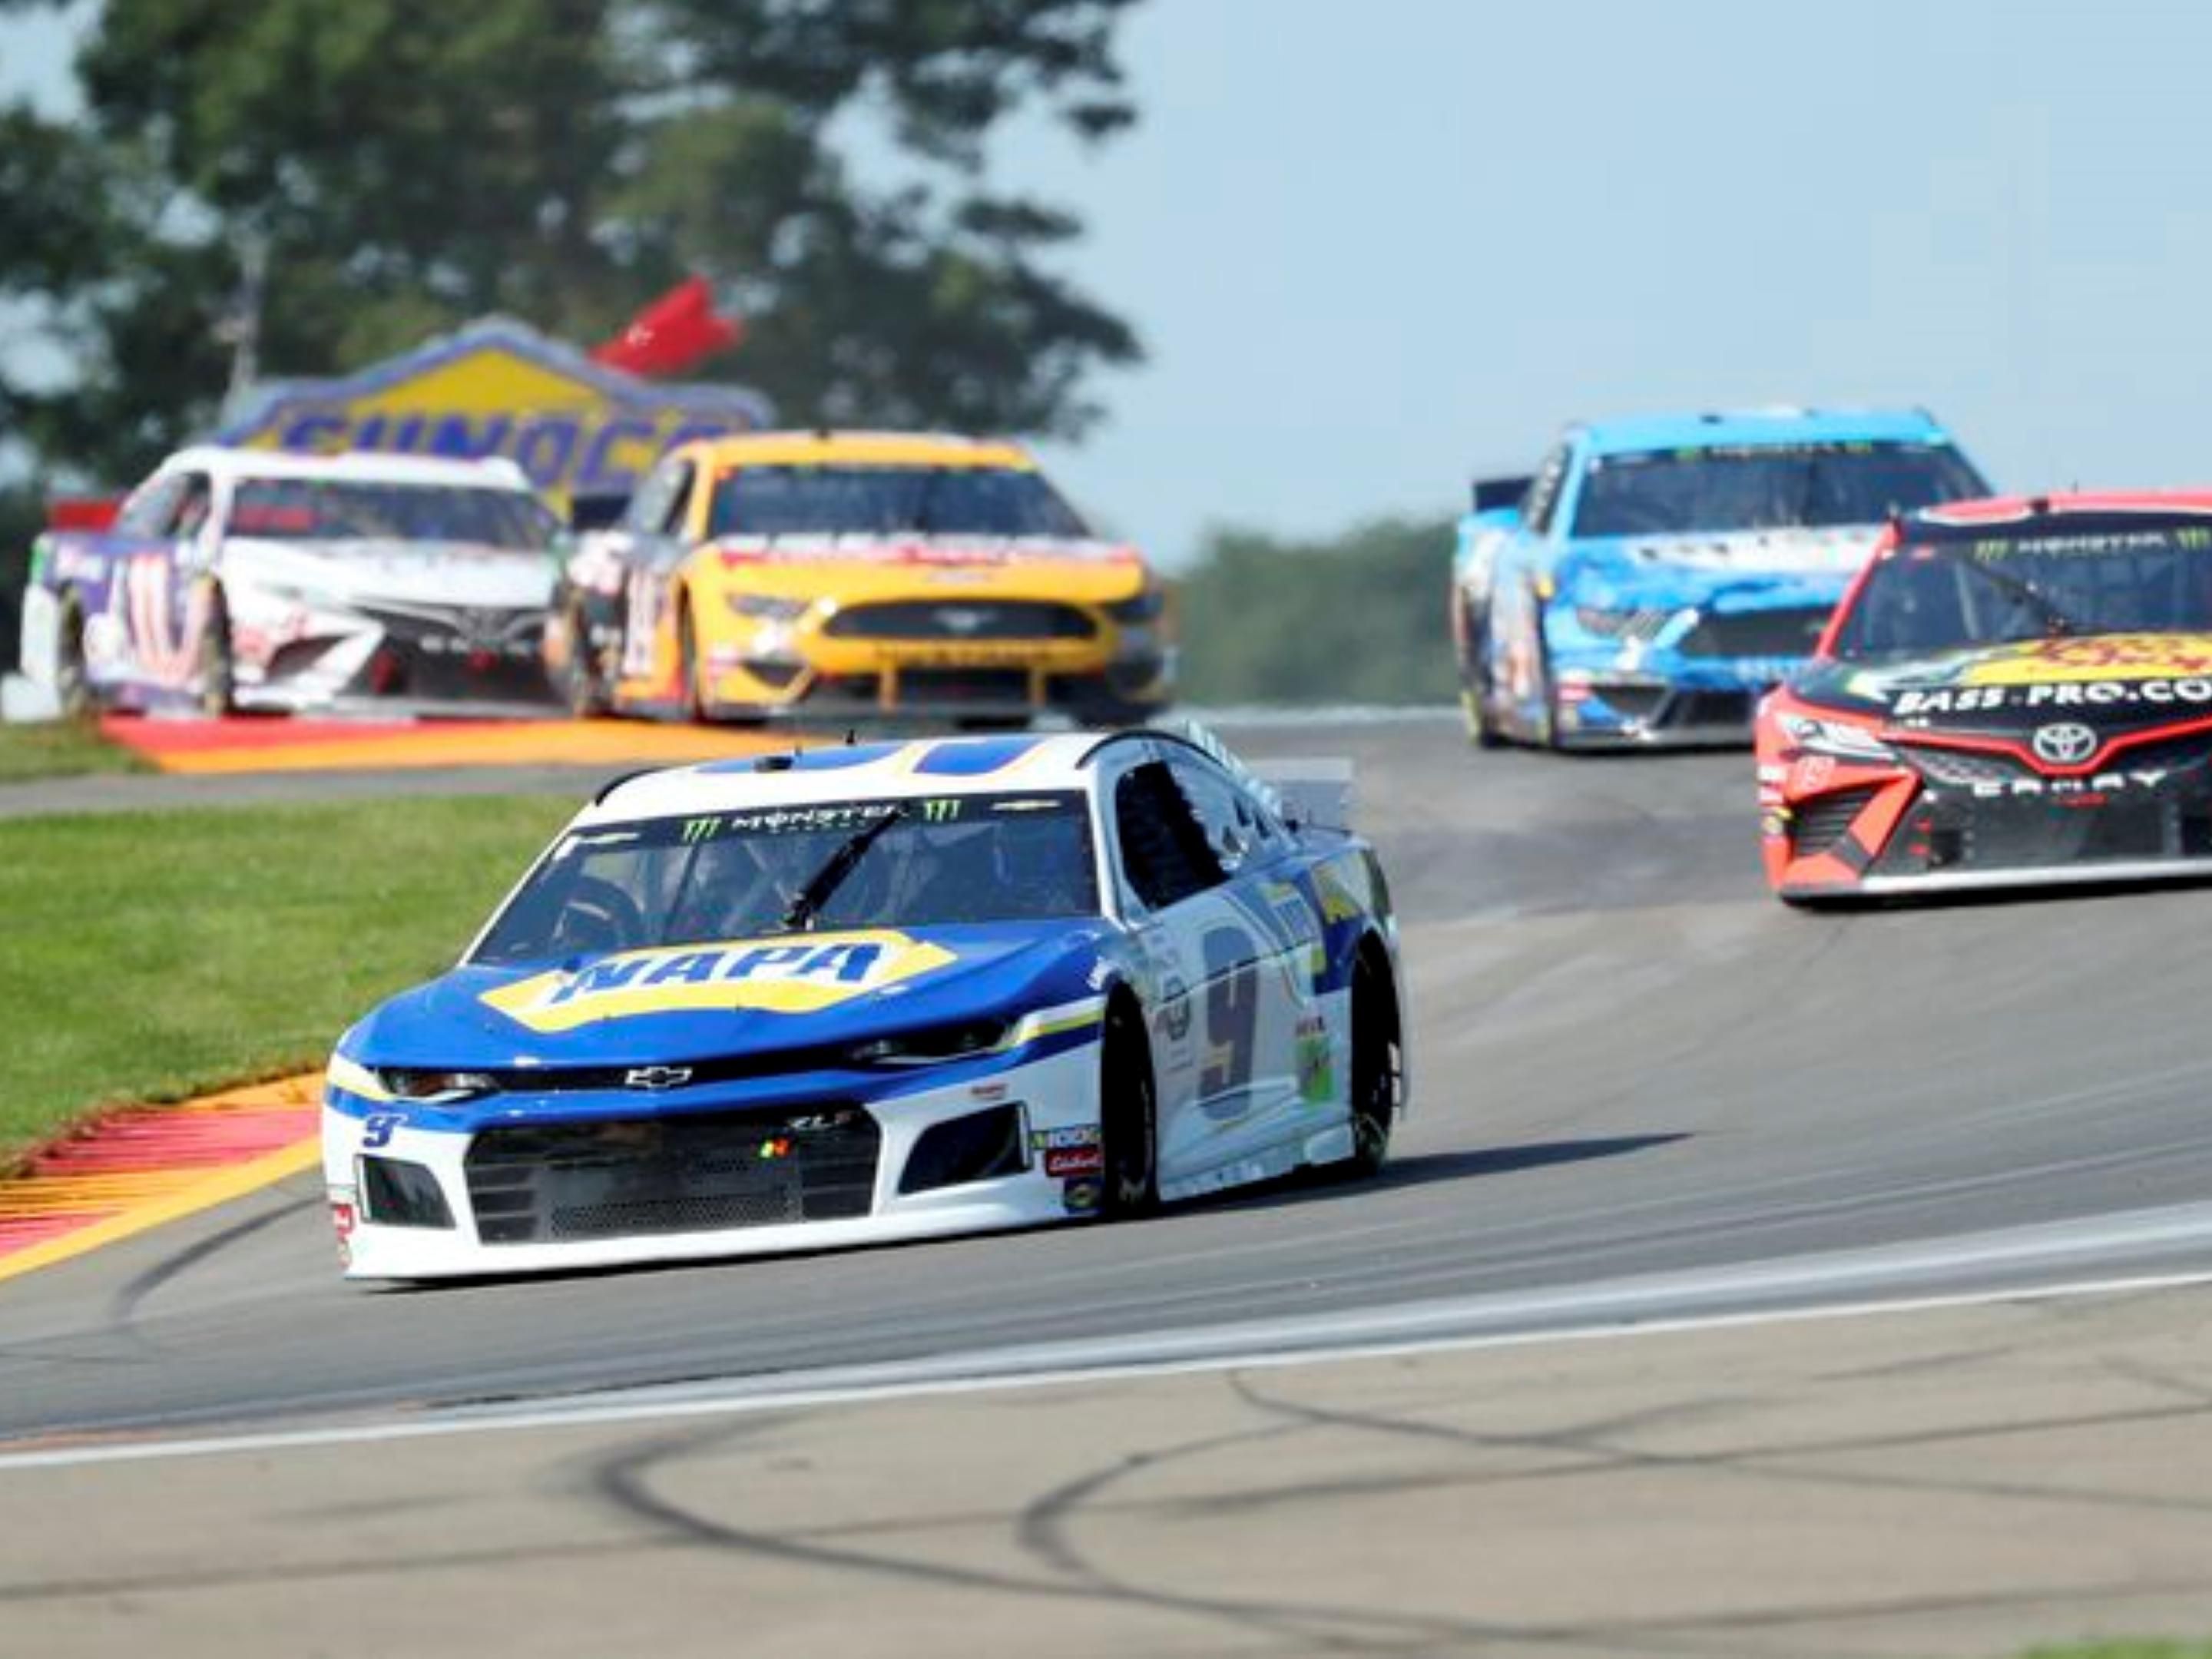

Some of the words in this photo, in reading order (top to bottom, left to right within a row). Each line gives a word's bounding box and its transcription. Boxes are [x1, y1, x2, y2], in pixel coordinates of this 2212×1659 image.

[551, 941, 886, 1004] NAPA
[1197, 926, 1258, 1120] 9
[363, 1114, 406, 1148] 9
